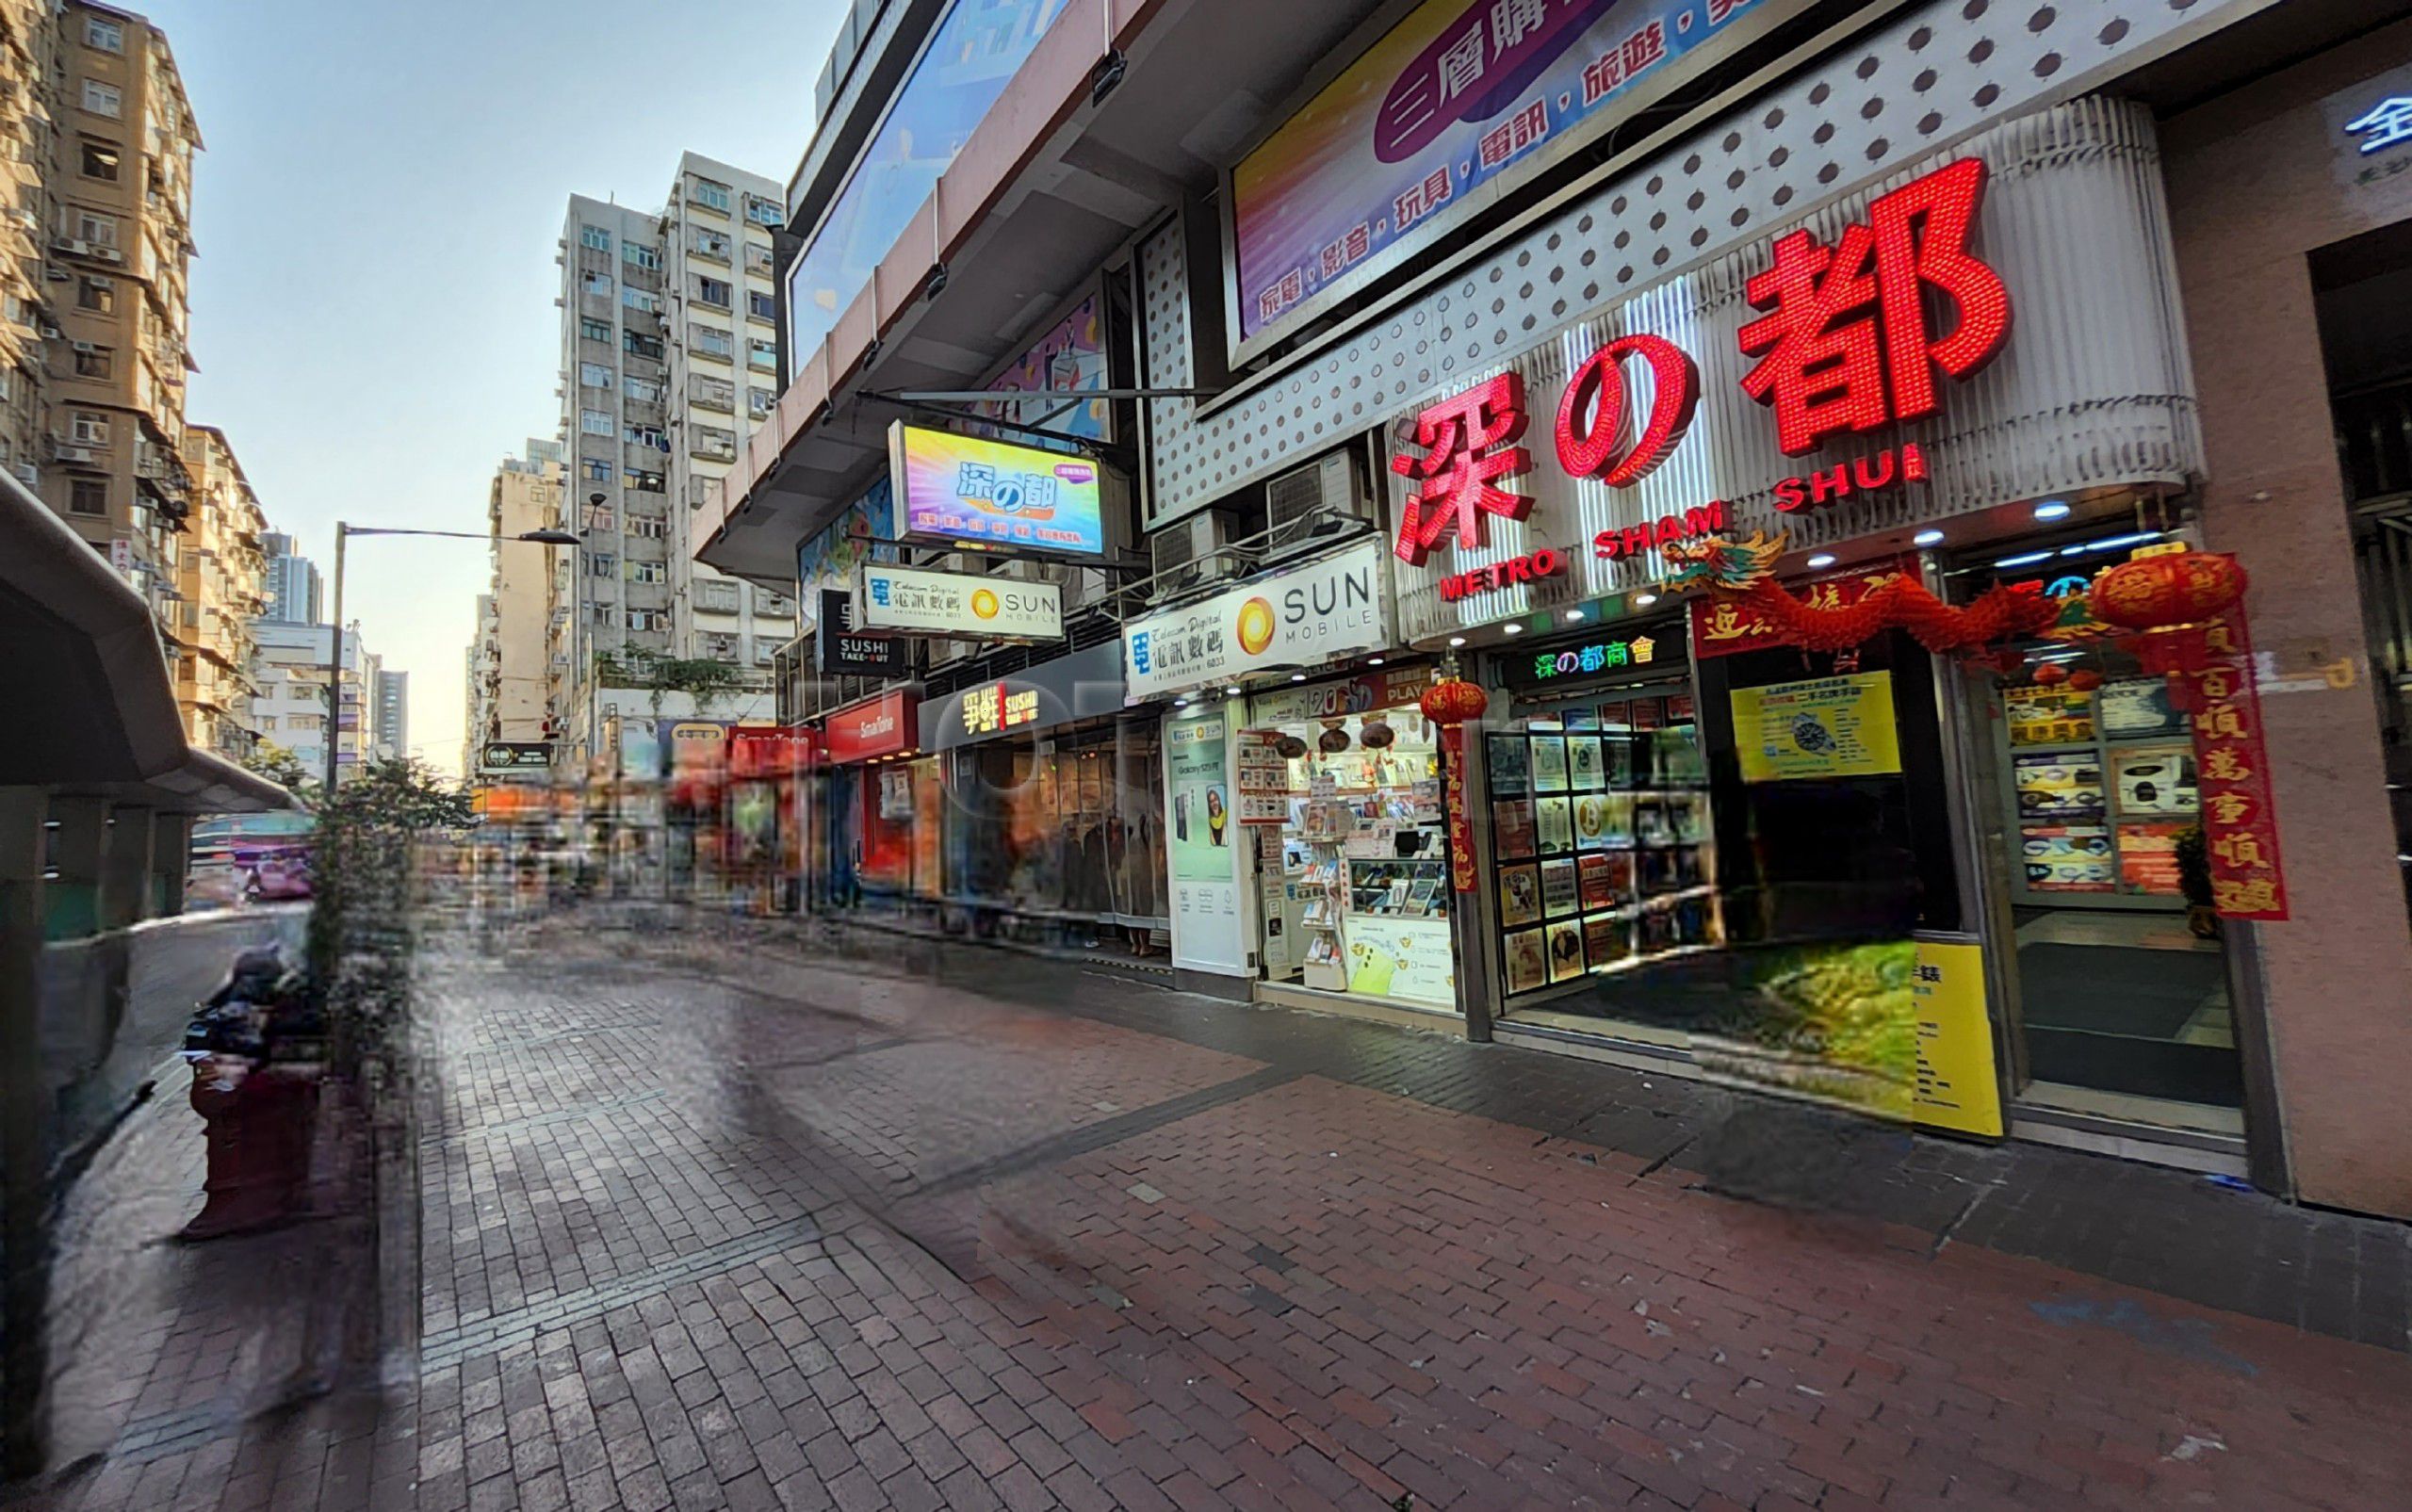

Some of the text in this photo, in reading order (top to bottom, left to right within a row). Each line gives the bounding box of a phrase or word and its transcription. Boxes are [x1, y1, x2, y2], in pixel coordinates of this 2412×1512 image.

[1393, 155, 2014, 567] 深の都
[957, 461, 1057, 513] 深の都
[1439, 442, 1925, 603] METRO SHAM SHUI
[1004, 593, 1056, 614] SUN
[1283, 566, 1369, 625] SUN
[1005, 613, 1056, 625] MOBILE
[1285, 610, 1372, 643] MOBILE
[840, 639, 888, 654] SUSHI
[1534, 635, 1656, 680] 深の都商會
[1005, 690, 1038, 714] SUSHI
[1387, 683, 1424, 703] PLAY
[860, 715, 893, 739] SmarTone
